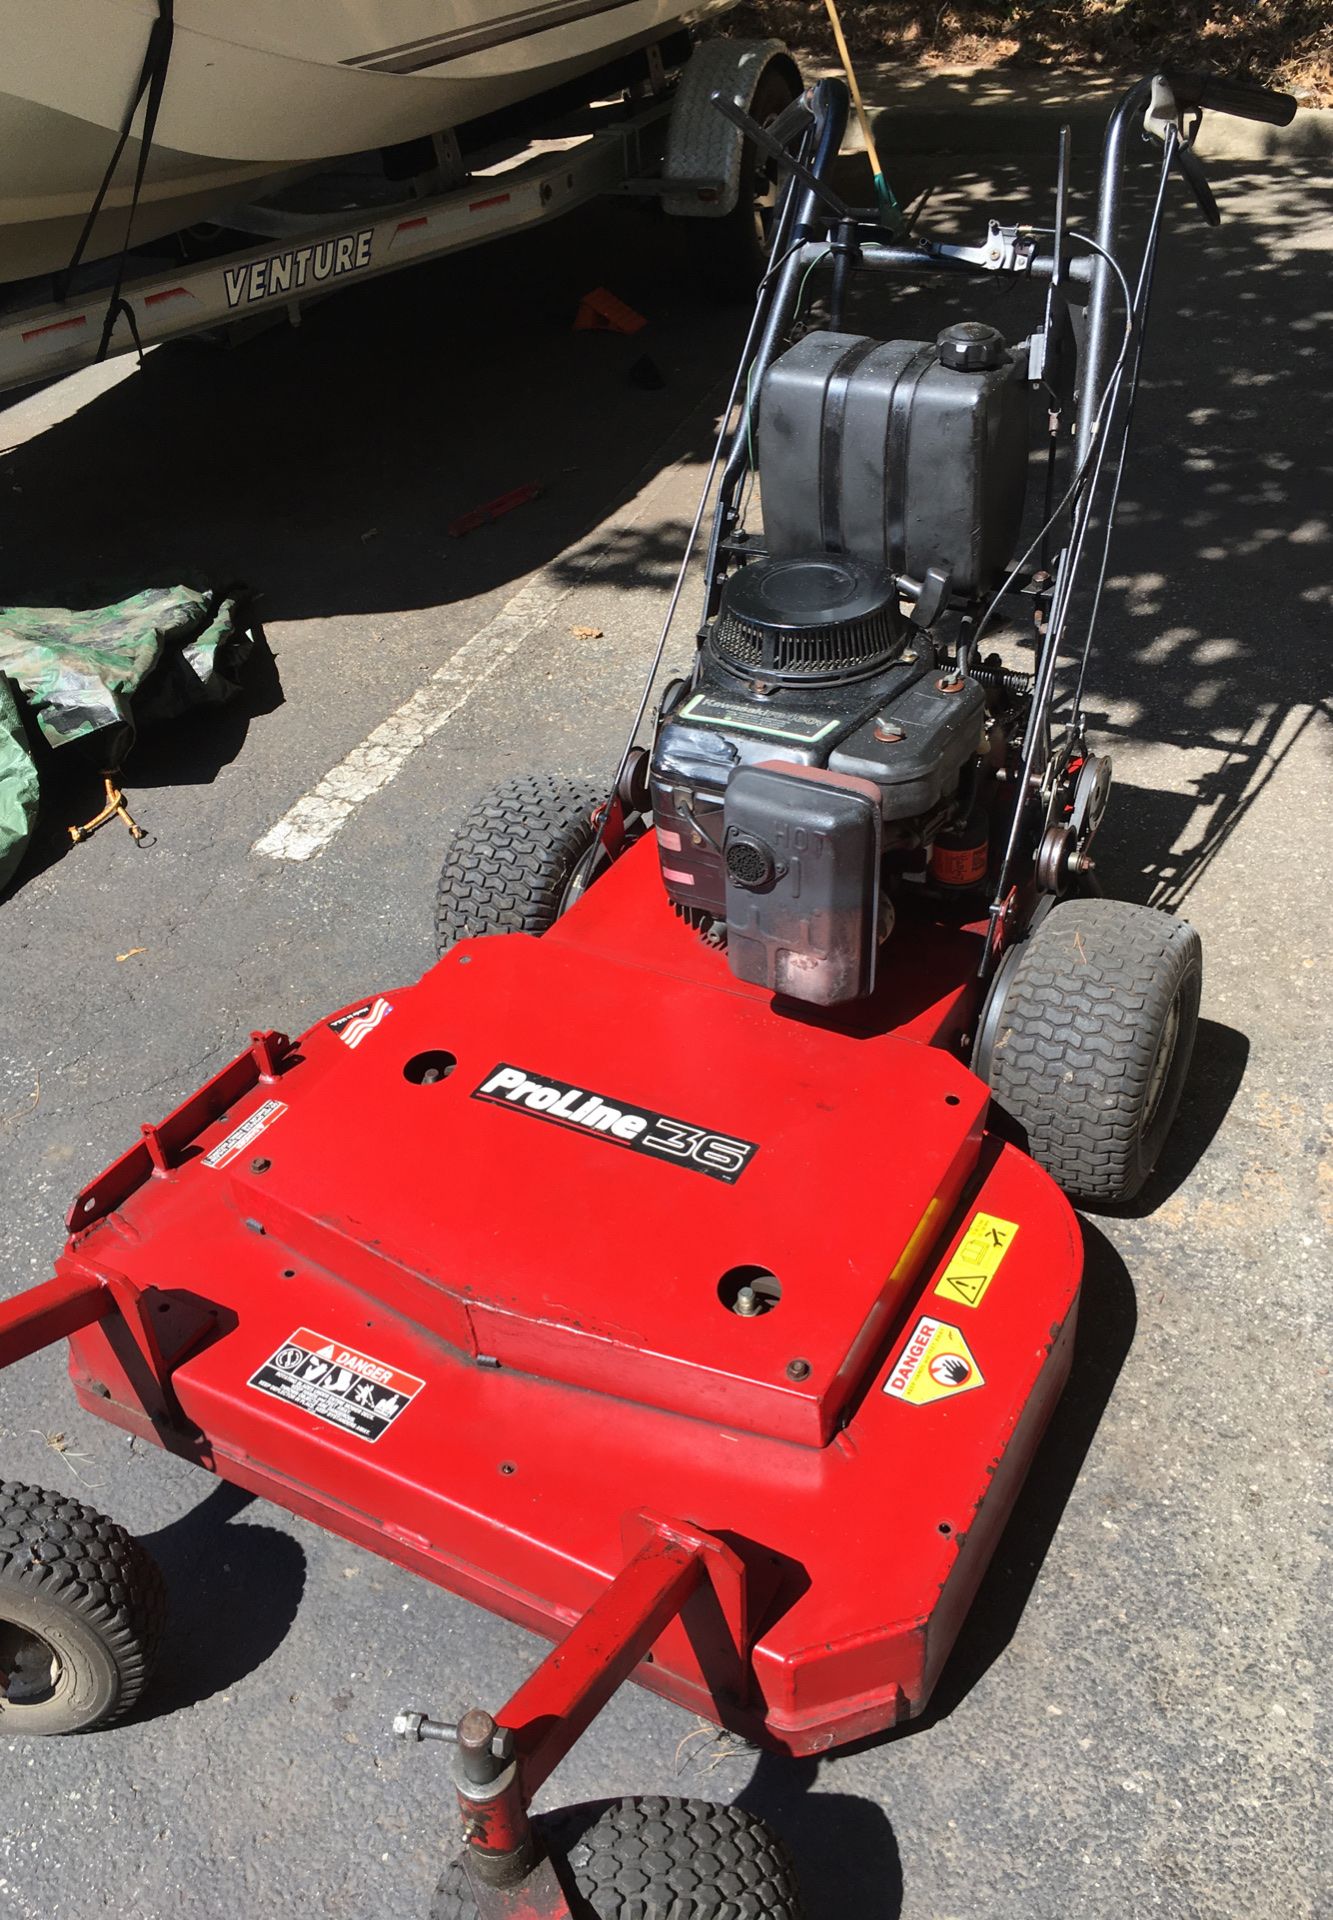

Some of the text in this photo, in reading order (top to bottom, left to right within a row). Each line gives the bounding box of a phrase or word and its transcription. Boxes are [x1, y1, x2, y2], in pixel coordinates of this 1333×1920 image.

[224, 228, 374, 308] VENTURE
[775, 823, 832, 858] HOT
[480, 1067, 751, 1172] ProLine 36
[335, 1351, 394, 1384] DANGER
[891, 1322, 935, 1392] DANGER
